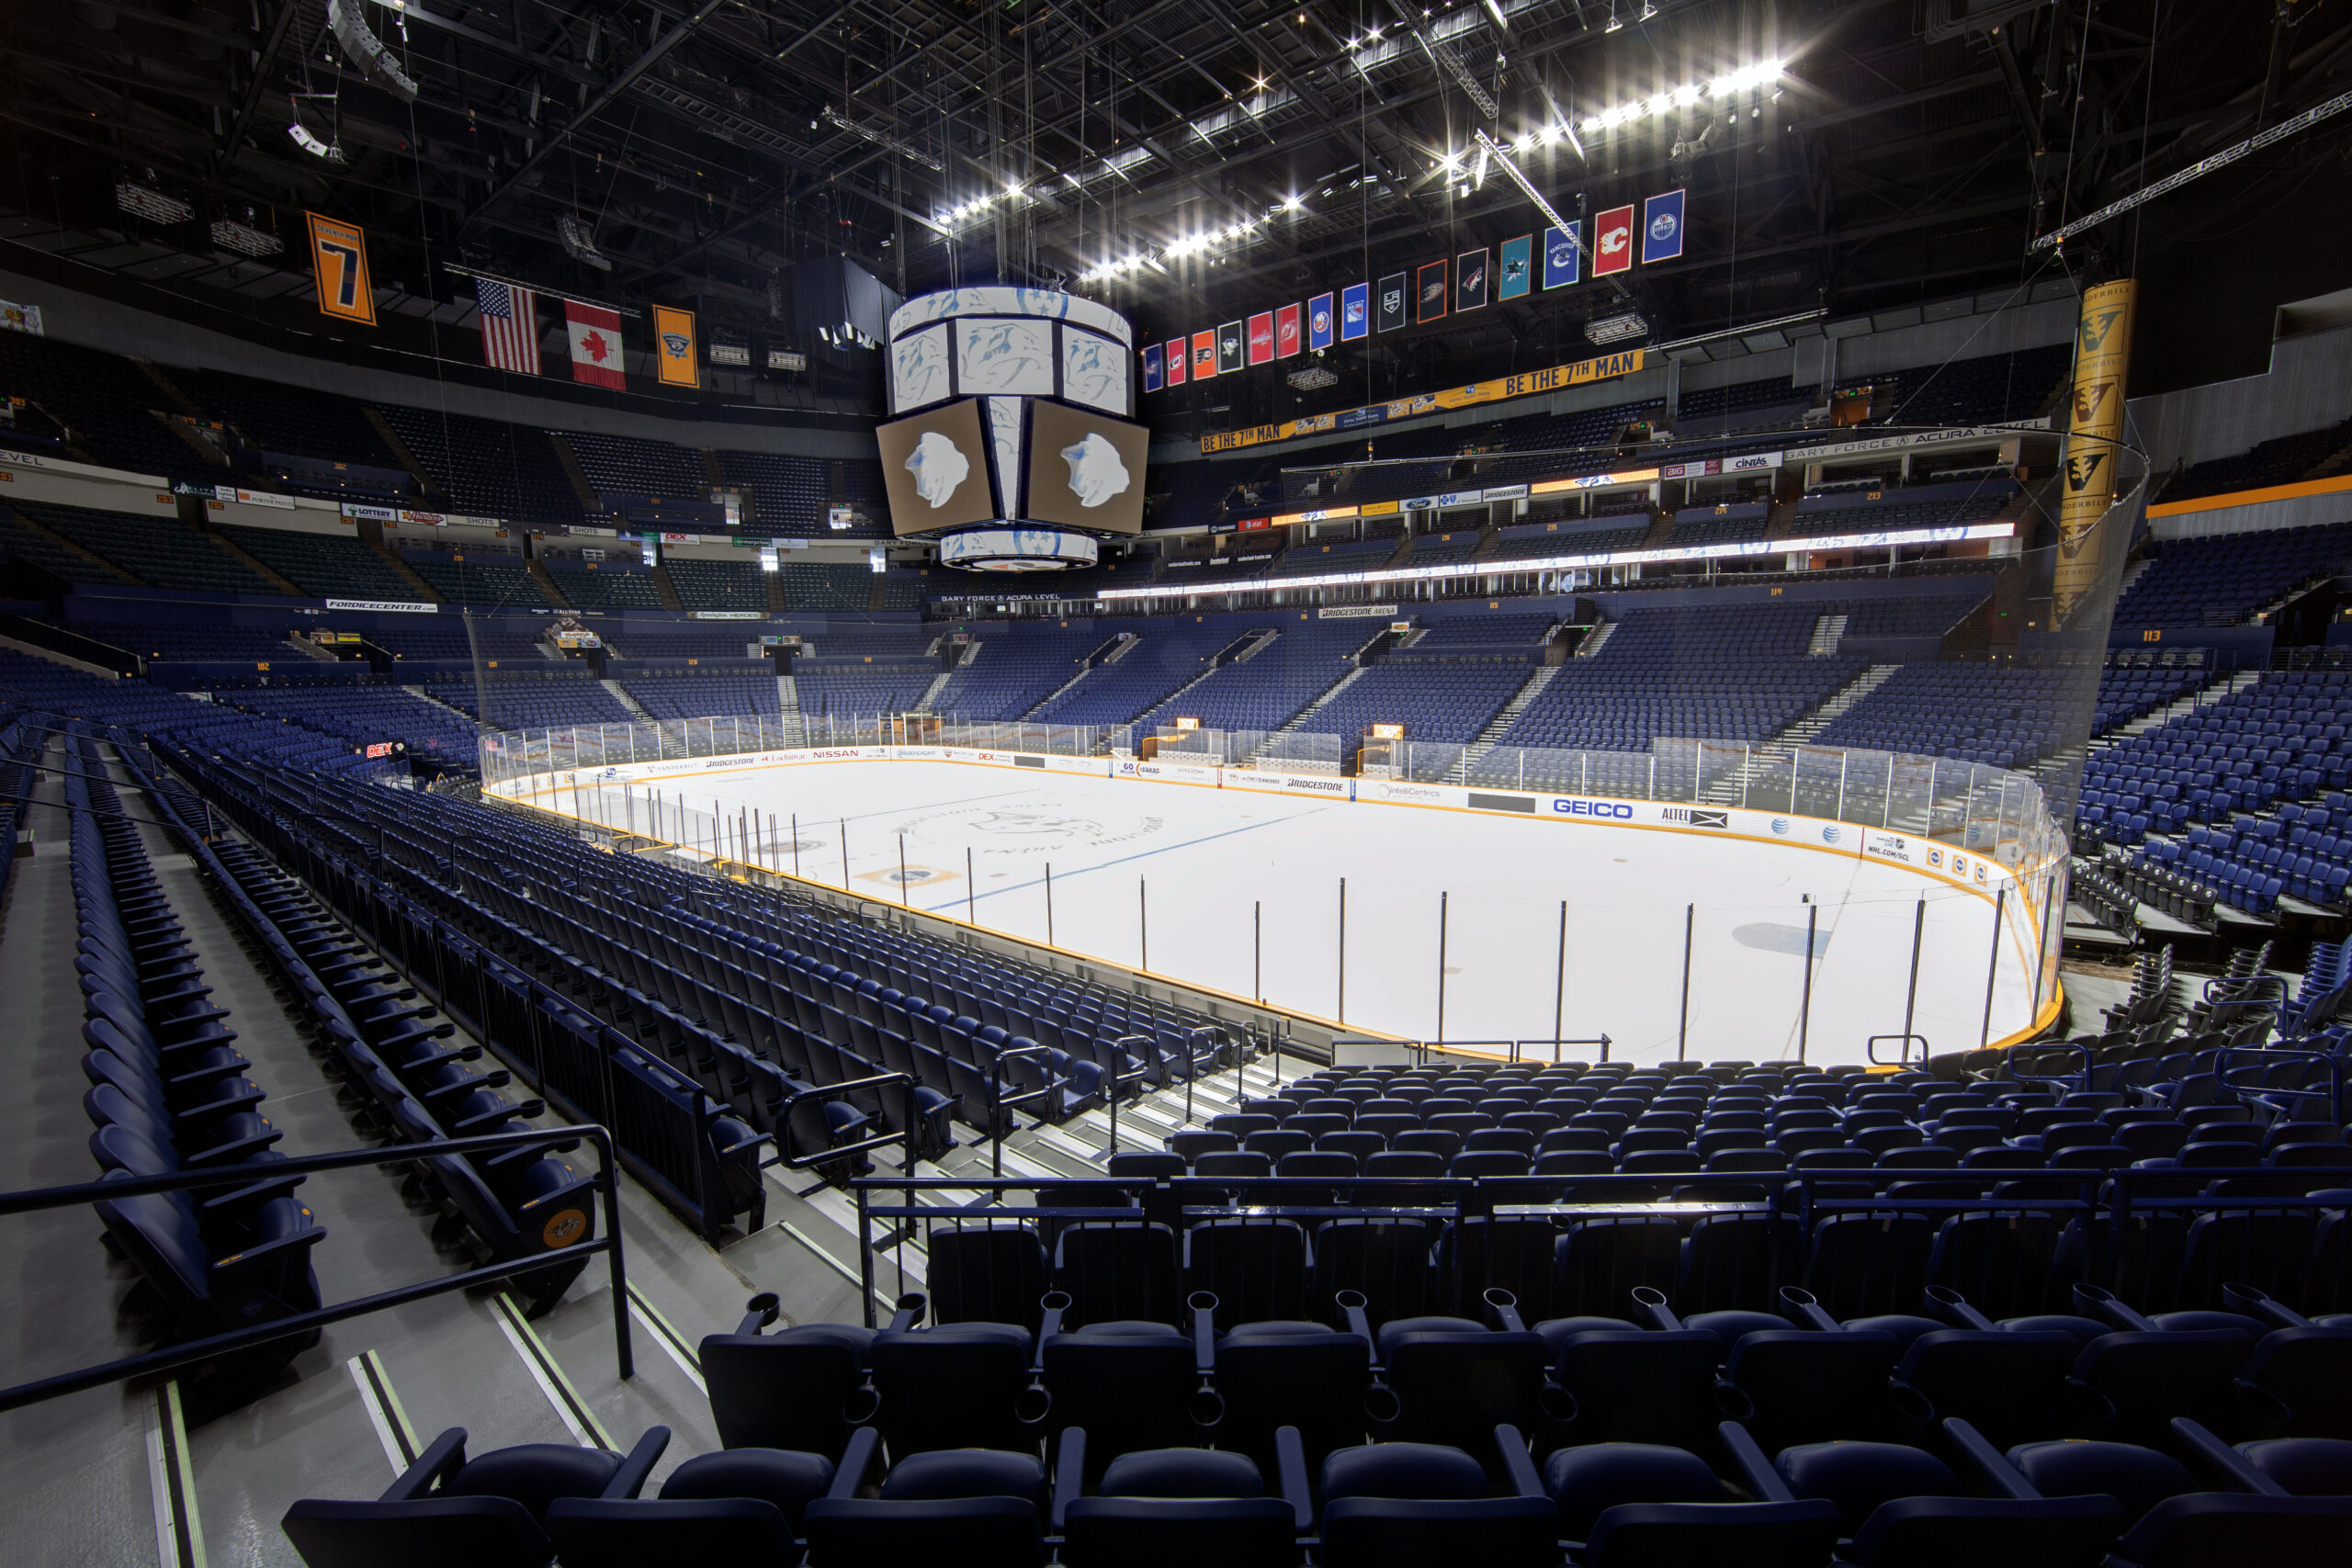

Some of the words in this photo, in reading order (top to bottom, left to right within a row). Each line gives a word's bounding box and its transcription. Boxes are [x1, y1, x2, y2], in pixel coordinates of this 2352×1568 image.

[1549, 242, 1576, 254] VANCOUVER
[319, 237, 360, 310] 7
[1384, 290, 1400, 304] LA
[1507, 376, 1525, 396] BE
[1532, 367, 1560, 390] THE
[1566, 364, 1589, 383] 7TH
[1596, 353, 1634, 378] MAN
[1204, 434, 1215, 451] BE
[1218, 431, 1237, 447] THE
[1239, 427, 1254, 445] 7TH
[1257, 425, 1280, 442] MAN
[1785, 447, 1819, 461] GARY
[1834, 440, 1891, 455] FORCE
[1916, 429, 1974, 444] ACURA
[1484, 488, 1526, 500] BRIDGESTONE
[1867, 492, 1881, 501] 213
[1409, 502, 1430, 510] Ford
[358, 507, 391, 518] LOTTERY
[466, 517, 495, 526] SHOTS
[573, 527, 598, 536] SHOTS
[666, 533, 686, 541] DEX
[735, 537, 770, 546] enterprise
[941, 595, 964, 605] GARY
[967, 595, 996, 604] FORCE
[1006, 593, 1034, 604] ACURA
[1035, 592, 1060, 603] LEVEL
[1322, 606, 1373, 619] BRIDGESTONE
[1374, 607, 1396, 616] ARENA
[2143, 630, 2162, 642] 113
[258, 662, 271, 671] 102
[366, 741, 394, 760] DEX
[813, 750, 859, 759] NISSAN
[978, 752, 994, 761] DEX
[707, 757, 756, 769] BRIDGESTONE
[772, 752, 807, 763] Lochinvar
[657, 763, 698, 773] VANDERBILT
[1287, 778, 1344, 792] BRIDGESTONE
[1390, 786, 1441, 798] IntelliCentrics
[1554, 798, 1634, 820] GEICO
[1661, 807, 1690, 823] ALTEC
